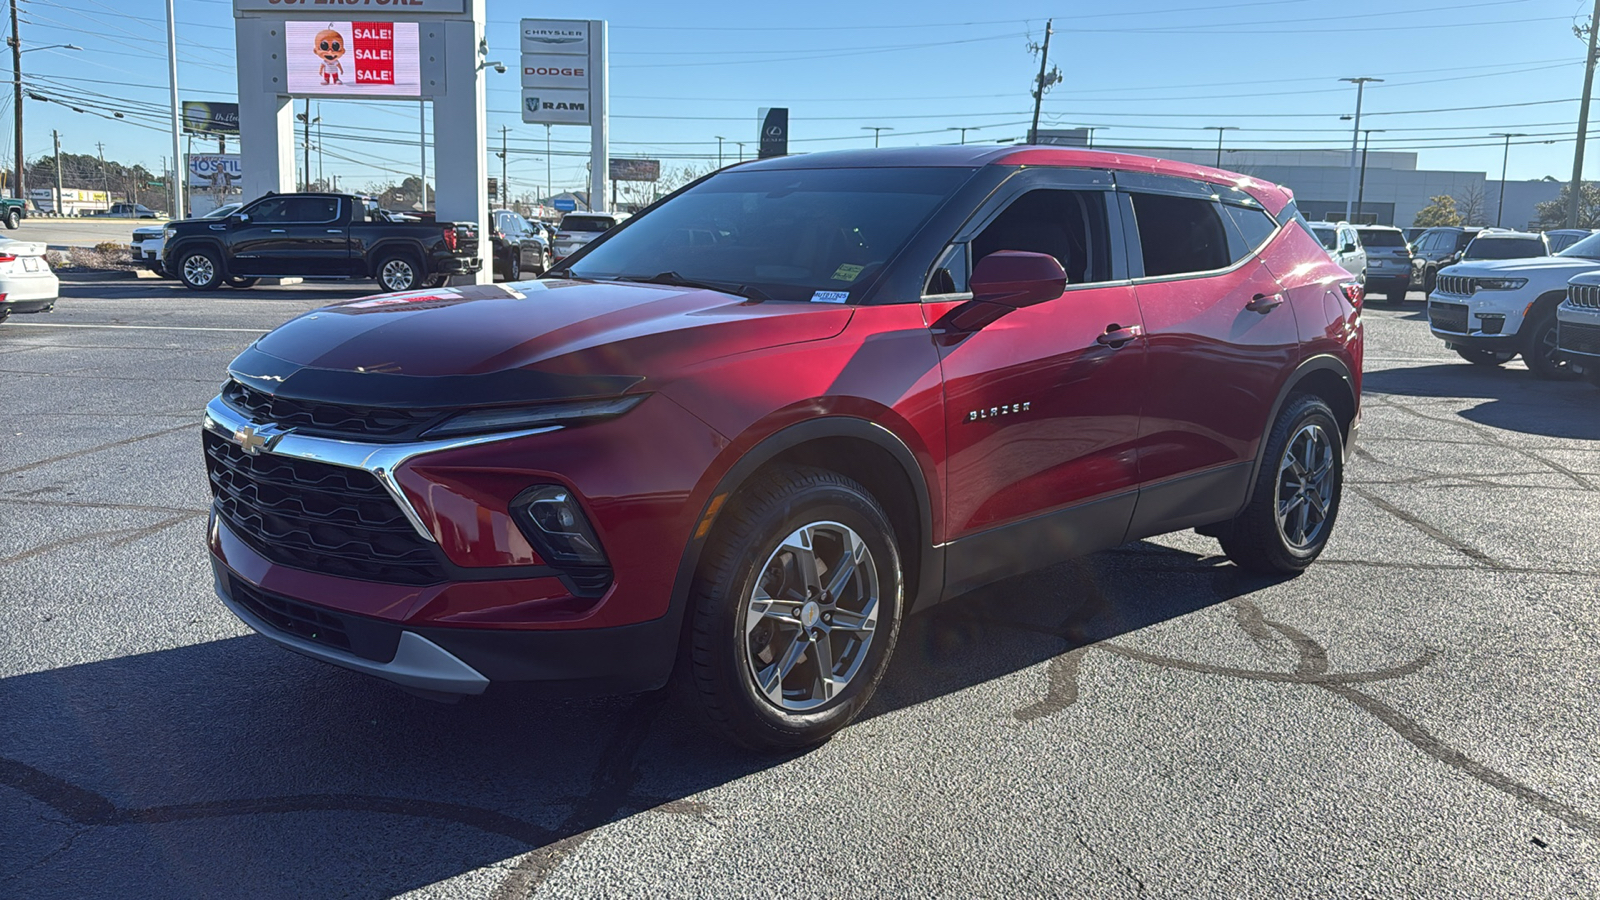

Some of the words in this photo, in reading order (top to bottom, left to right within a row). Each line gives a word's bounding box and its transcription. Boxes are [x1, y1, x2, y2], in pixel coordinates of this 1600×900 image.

[354, 28, 392, 40] SALE!
[525, 29, 582, 37] CHRYSLER
[355, 49, 392, 60] SALE!
[357, 69, 392, 81] SALE!
[524, 67, 585, 77] DODGE
[542, 101, 585, 111] RAM
[969, 401, 1031, 421] BLAZER
